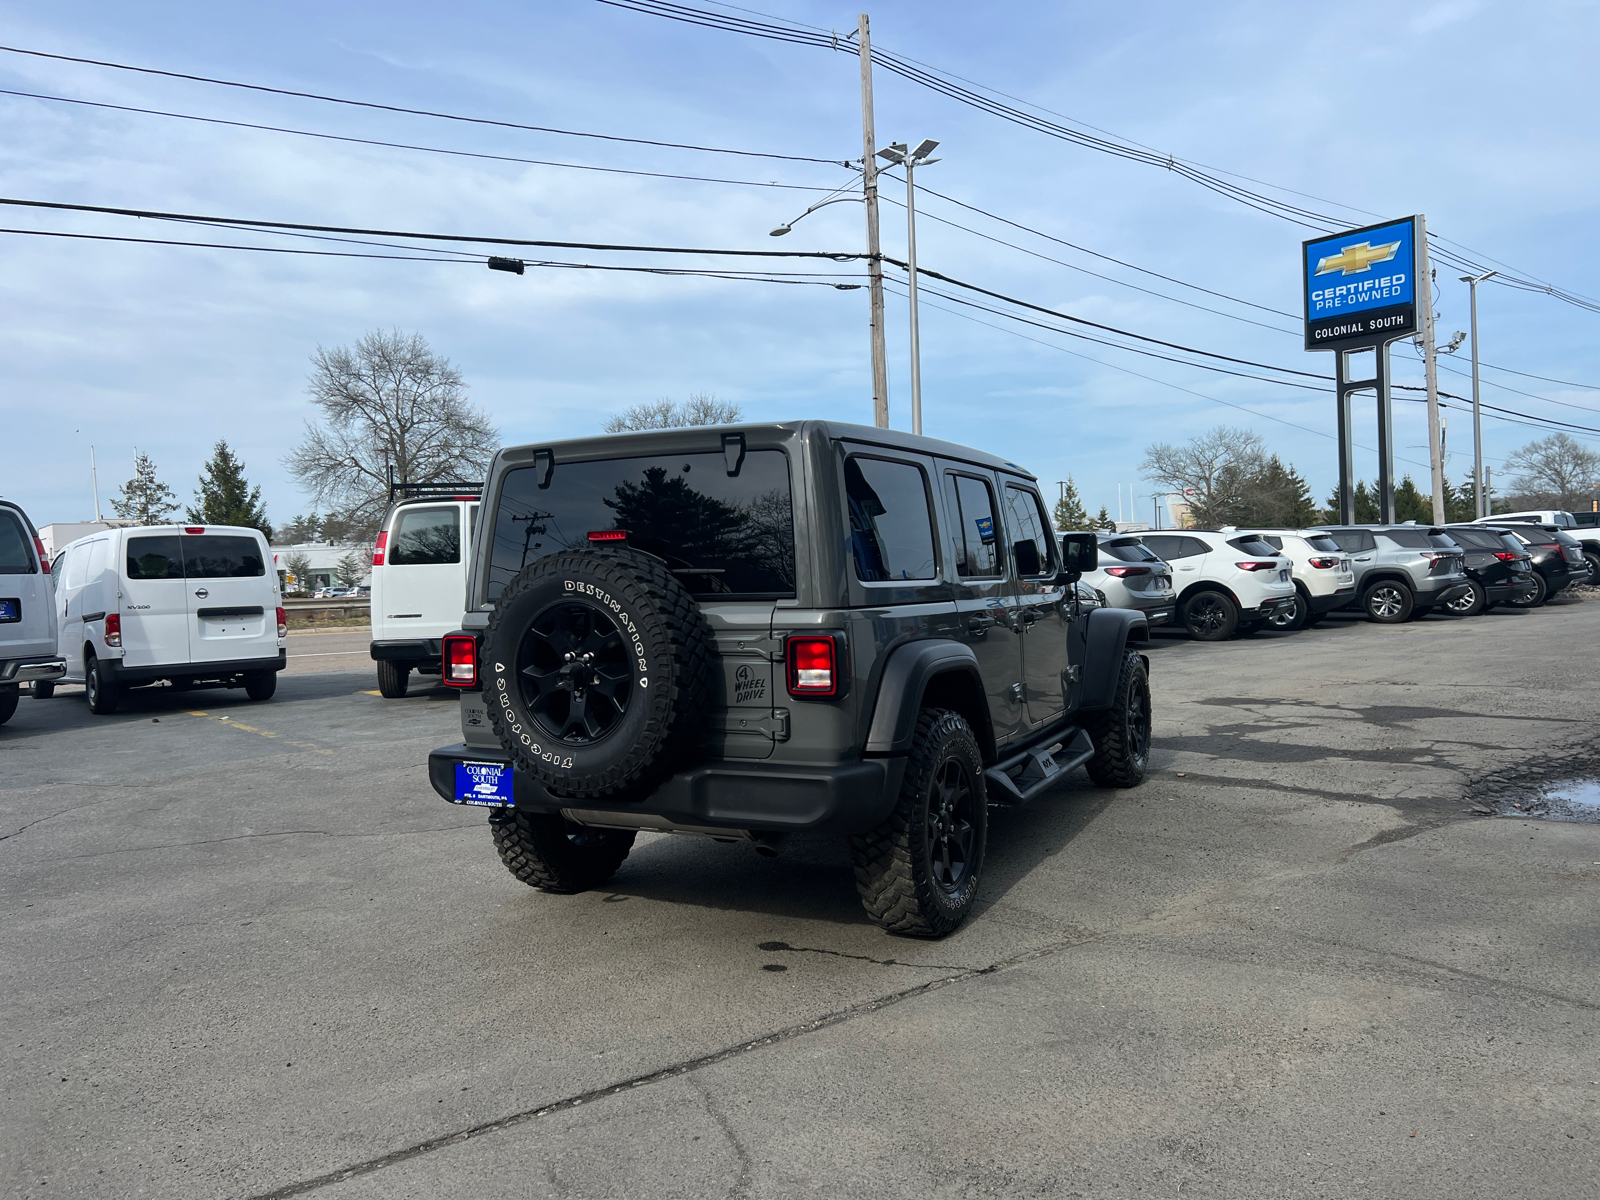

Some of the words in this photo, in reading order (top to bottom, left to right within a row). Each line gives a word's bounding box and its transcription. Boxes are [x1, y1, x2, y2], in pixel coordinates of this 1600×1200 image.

[1311, 273, 1406, 301] CERTIFIED
[1316, 285, 1401, 311] PRE-OWNED
[1315, 322, 1364, 339] COLONIAL
[1369, 315, 1404, 330] SOUTH
[564, 580, 648, 672] DESTINATION
[738, 667, 749, 680] 4
[735, 678, 766, 692] WHEEL
[736, 688, 766, 703] DRIVE
[466, 766, 504, 776] COLONIAL
[472, 774, 498, 784] SOUTH
